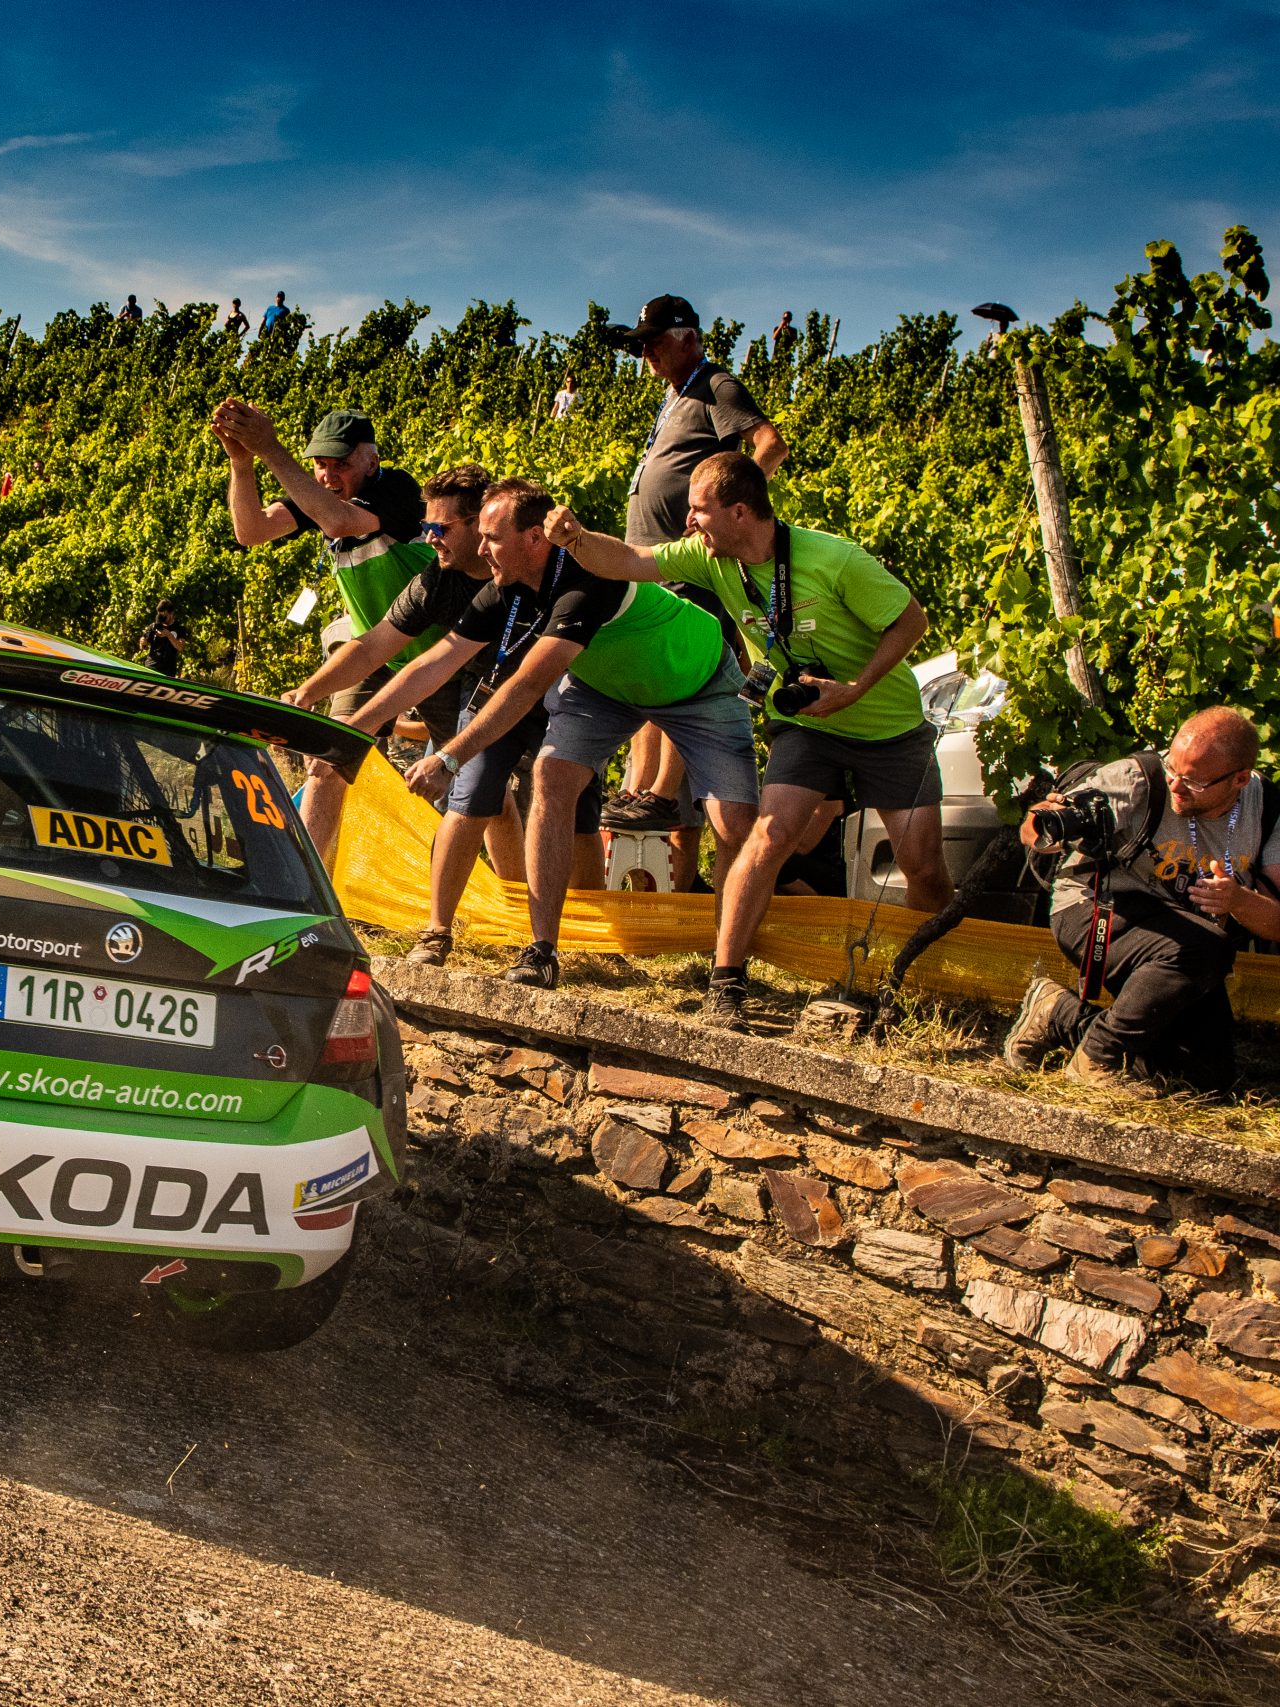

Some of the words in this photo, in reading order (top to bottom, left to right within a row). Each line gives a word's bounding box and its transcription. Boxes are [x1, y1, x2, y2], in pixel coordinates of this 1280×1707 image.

[505, 605, 518, 627] RALLY
[76, 673, 124, 692] Castrol
[124, 682, 222, 710] EDGE
[231, 769, 285, 830] 23
[48, 812, 158, 860] ADAC
[1097, 919, 1107, 943] EOS
[234, 933, 300, 986] R5
[300, 933, 319, 948] evo
[1094, 944, 1104, 962] 80D
[18, 975, 85, 1024] 11R
[114, 991, 199, 1038] 0426
[320, 1163, 365, 1192] MICHELIN
